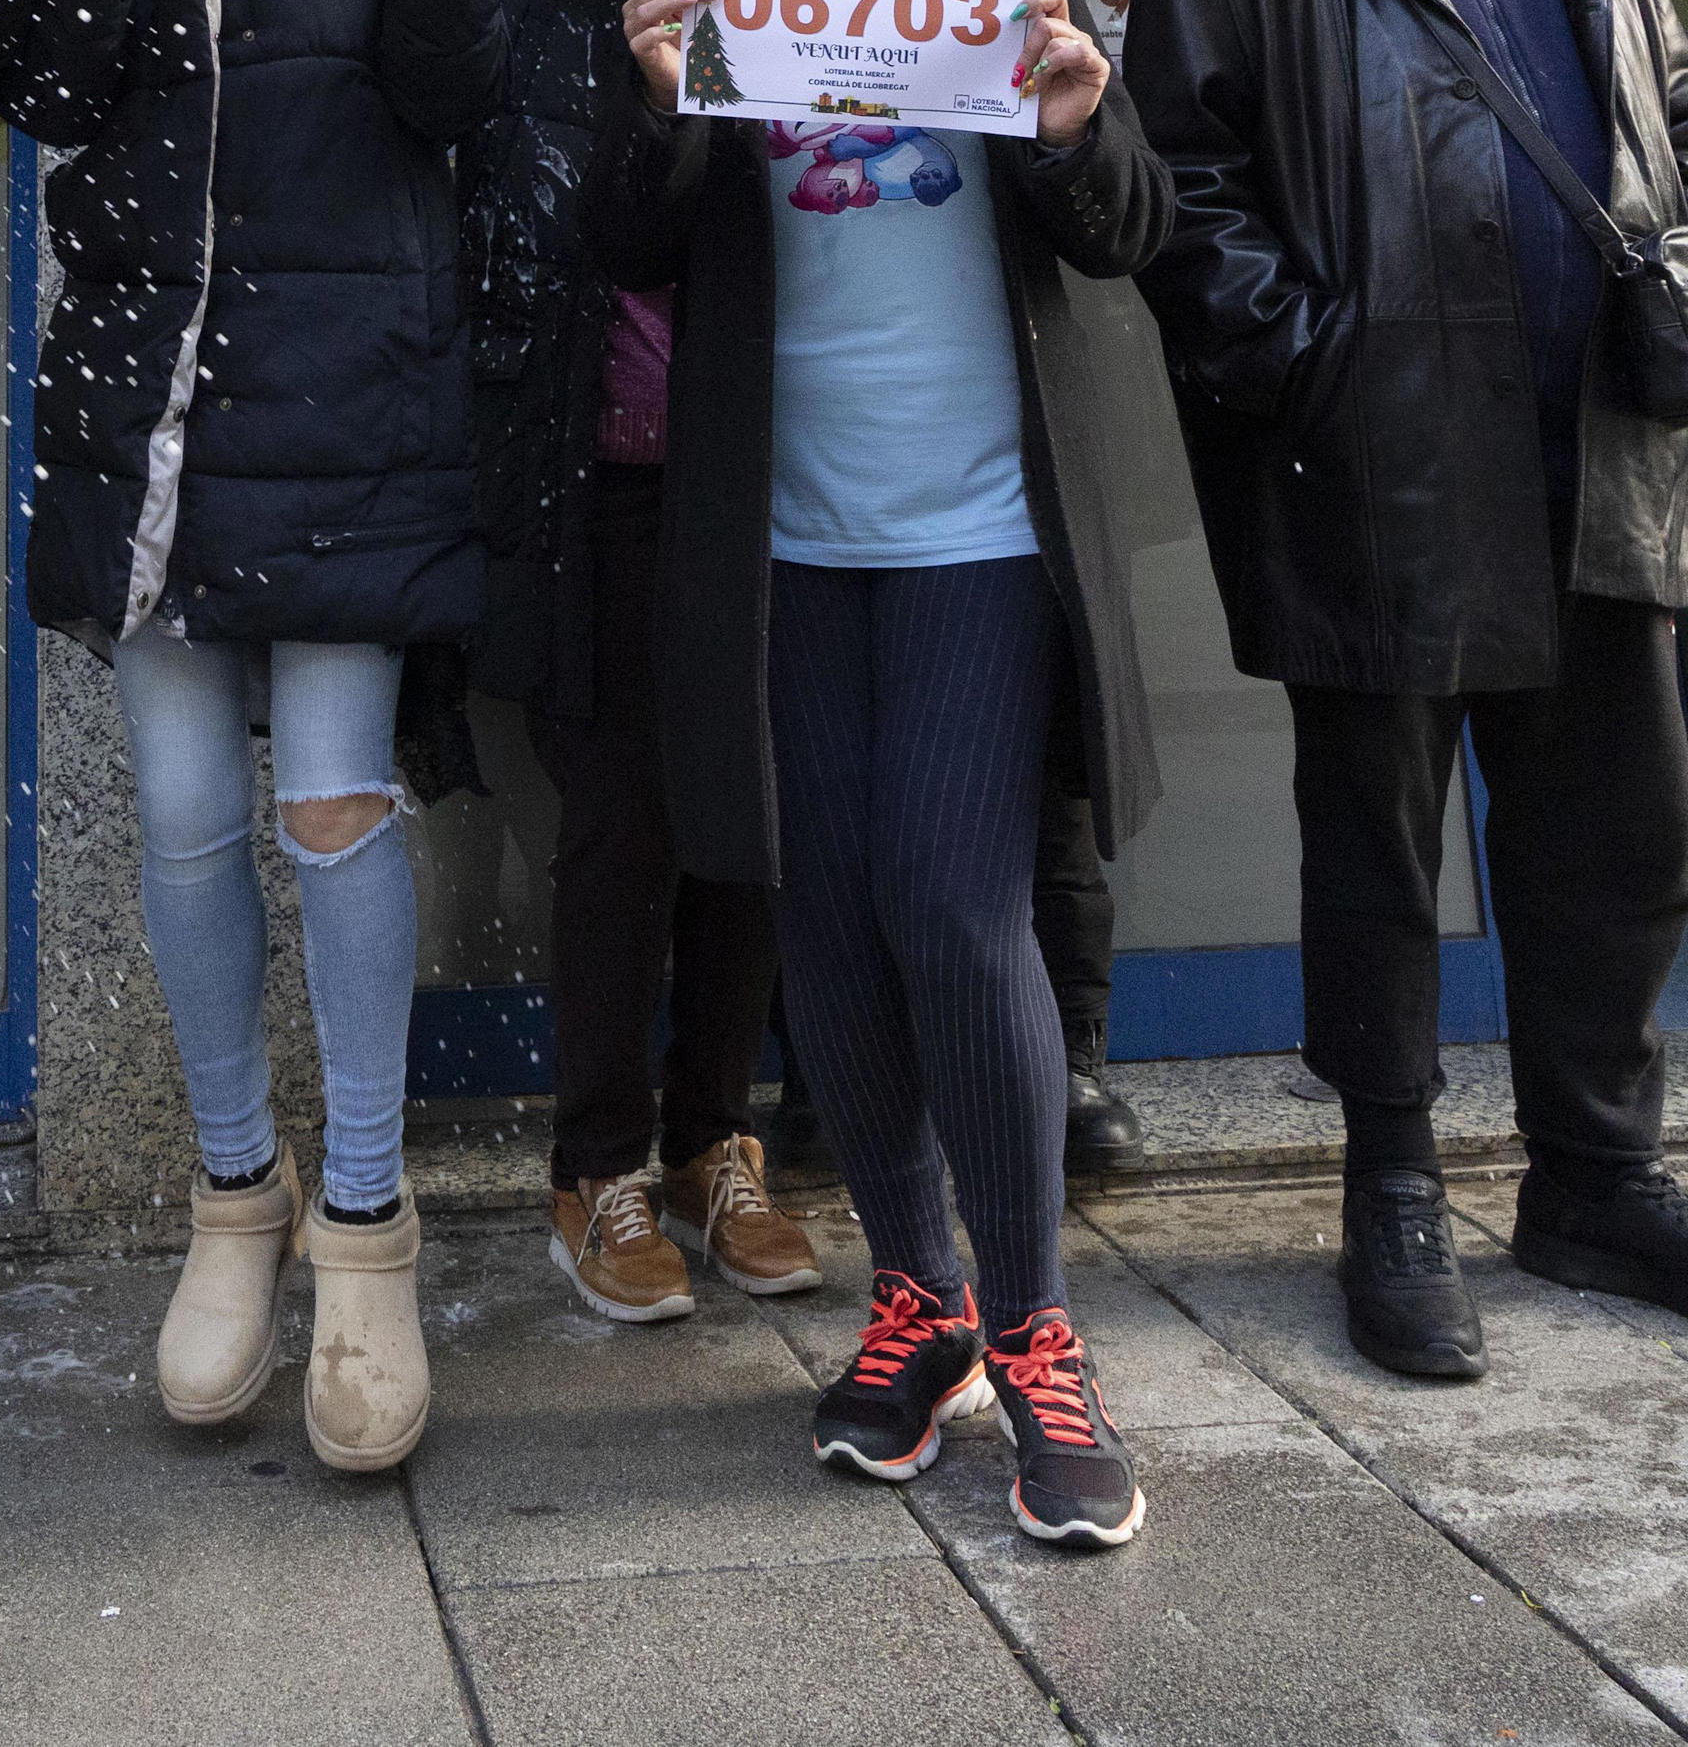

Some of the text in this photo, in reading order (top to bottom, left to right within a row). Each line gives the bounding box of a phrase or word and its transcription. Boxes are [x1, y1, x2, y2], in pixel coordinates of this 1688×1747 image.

[791, 42, 919, 67] VENUT AQUÍ
[865, 71, 896, 79] MERCAT
[864, 82, 910, 91] LLOBREGAT
[971, 98, 1011, 114] LOTERÍA NACIONAL
